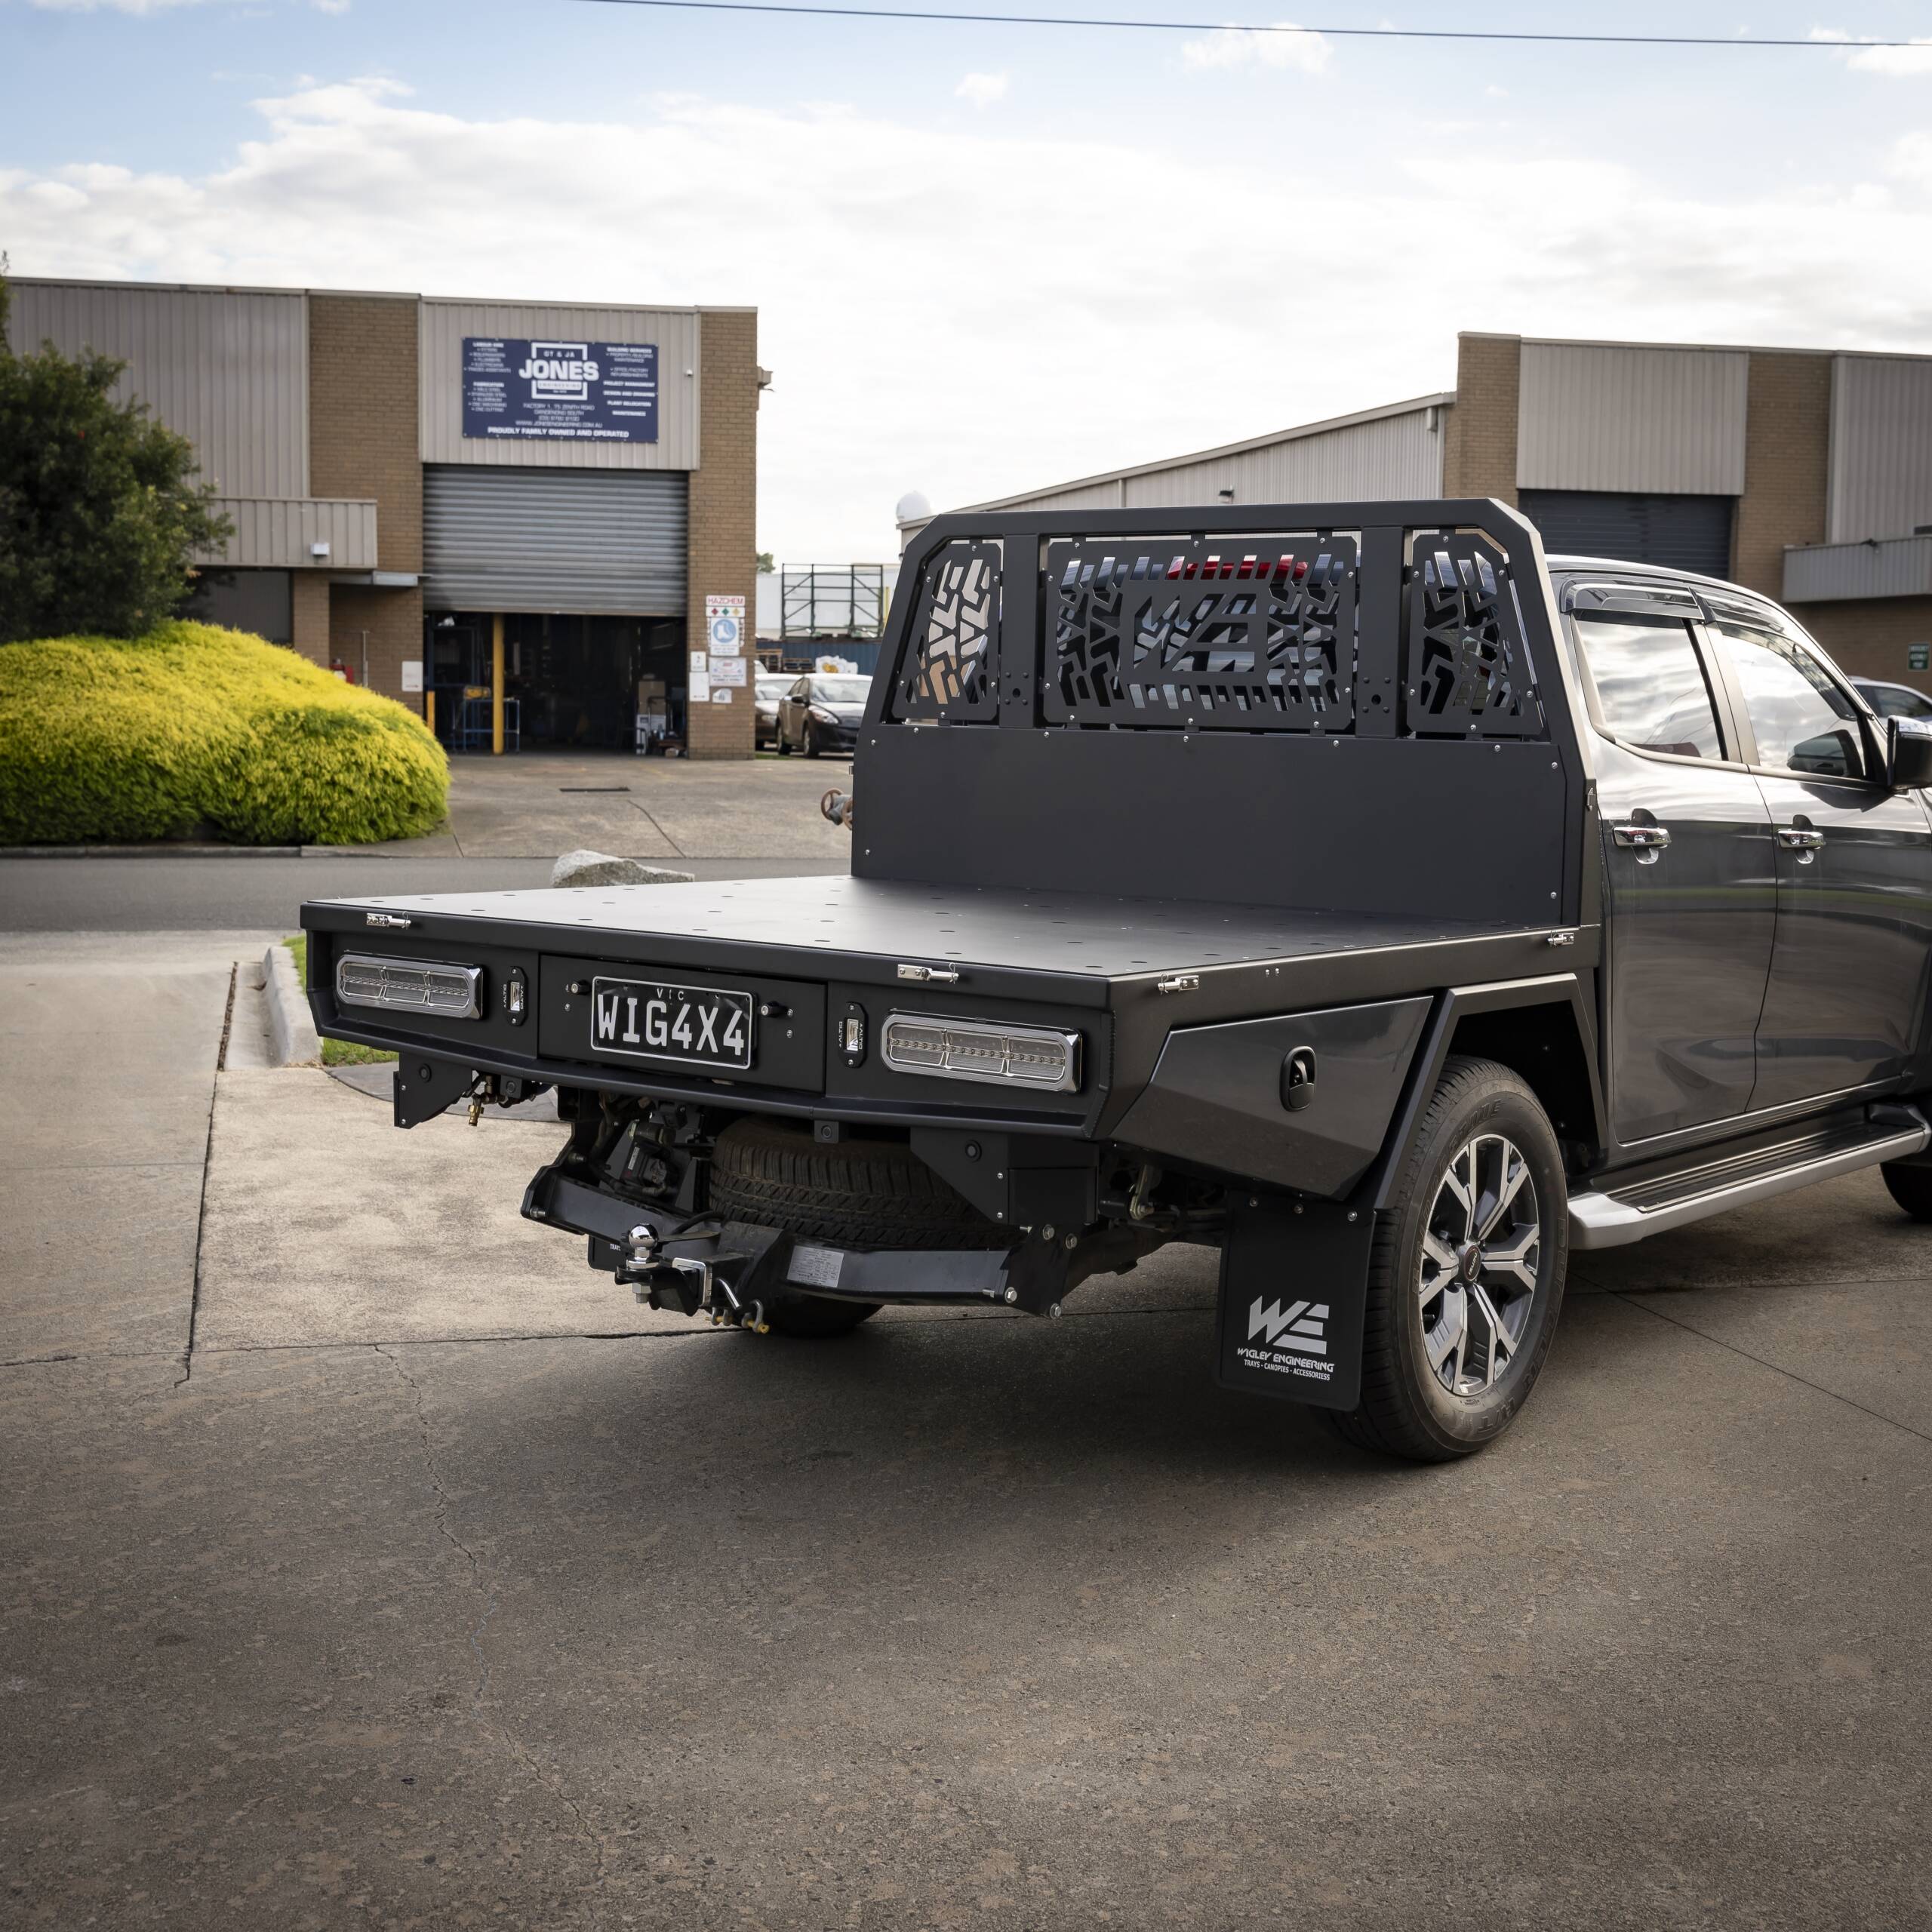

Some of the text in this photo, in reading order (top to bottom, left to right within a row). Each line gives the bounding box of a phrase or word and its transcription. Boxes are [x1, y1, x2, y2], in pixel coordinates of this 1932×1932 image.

[518, 358, 599, 381] JONES
[656, 988, 685, 1001] VIC
[597, 994, 744, 1056] WIG4X4
[1238, 1347, 1334, 1373] WIGLEY ENGINEERING
[1244, 1359, 1260, 1367] TRAYS
[1264, 1363, 1289, 1374] CANOPIES
[1293, 1368, 1330, 1381] ACCESSORIESS
